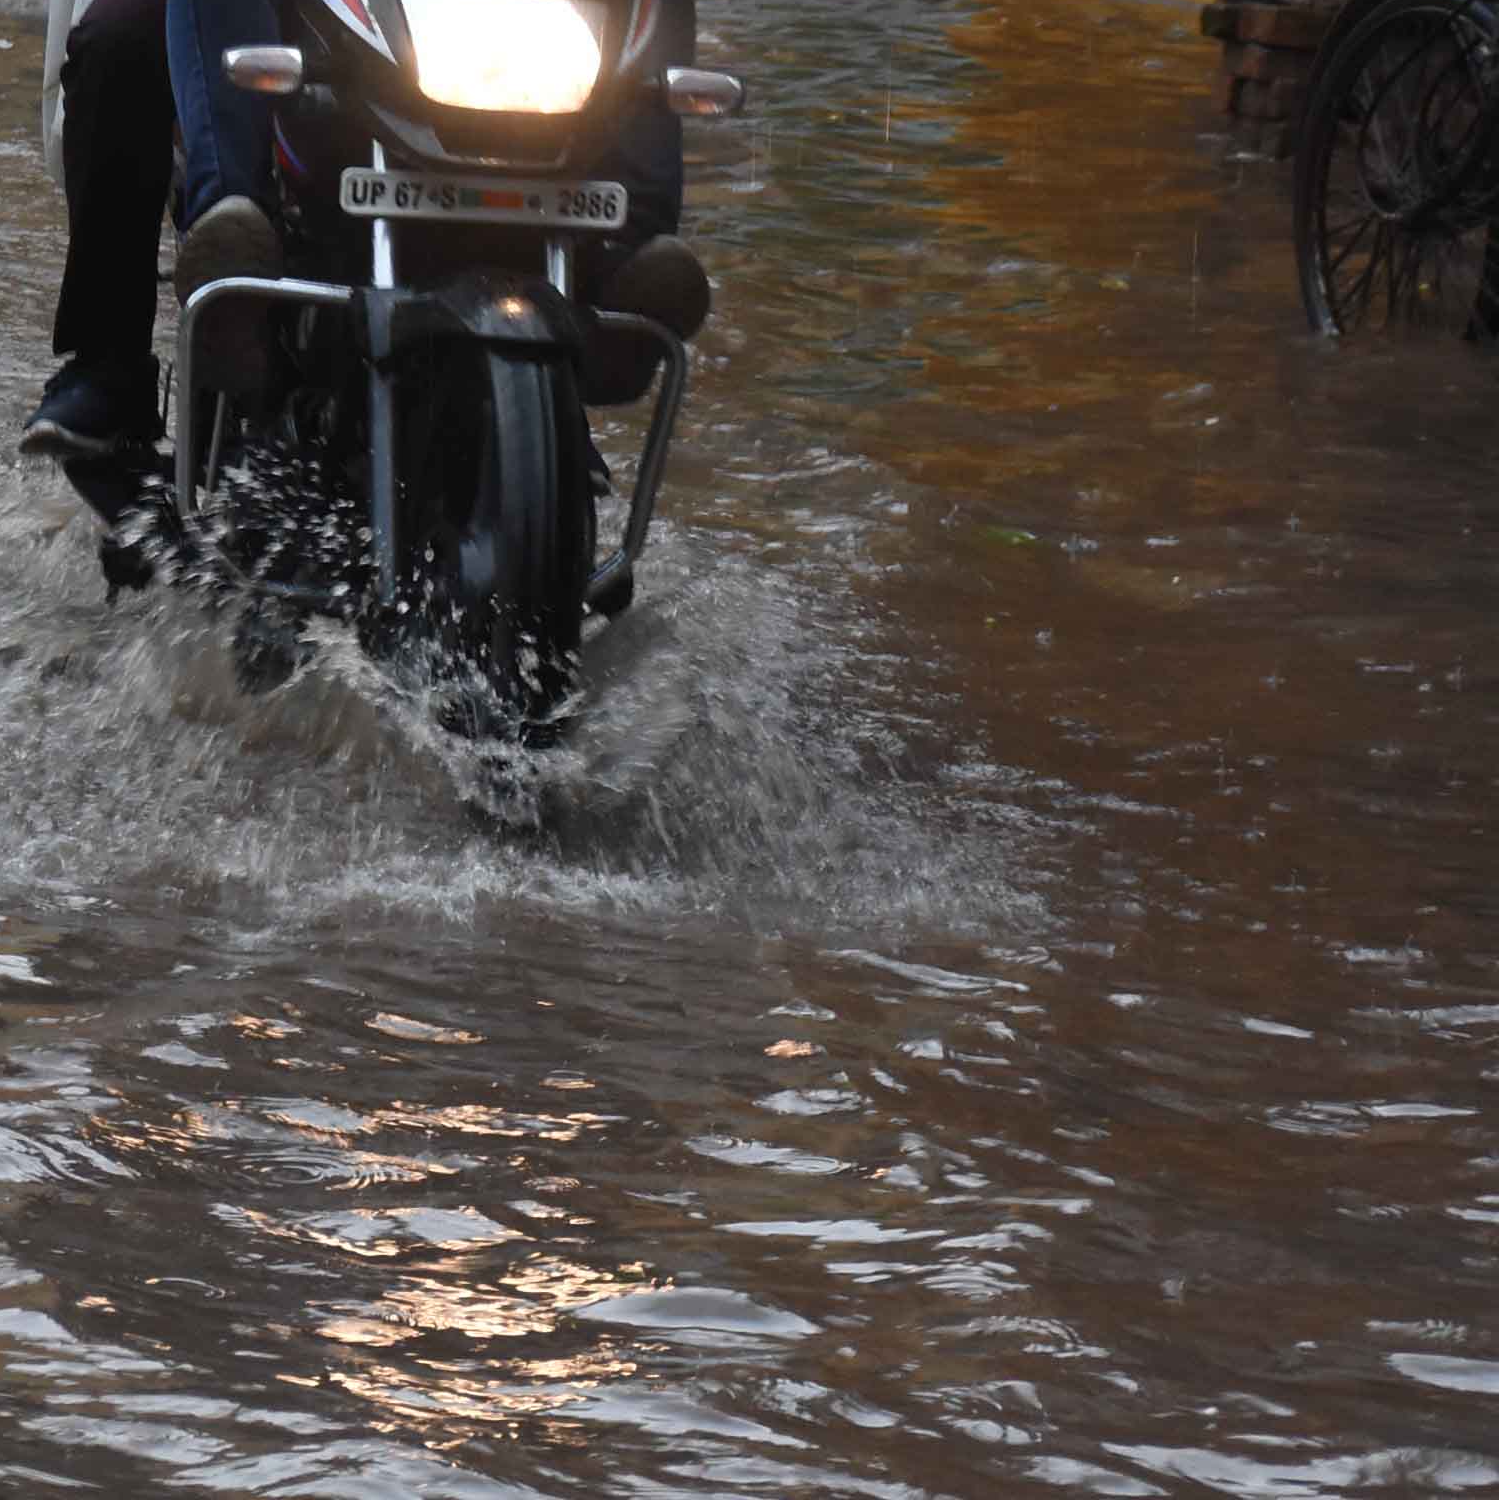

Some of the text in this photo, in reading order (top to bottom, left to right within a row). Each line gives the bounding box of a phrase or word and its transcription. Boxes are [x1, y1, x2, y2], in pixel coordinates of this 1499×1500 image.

[352, 180, 386, 206] UP
[394, 181, 423, 209] 67
[558, 188, 617, 219] 2986
